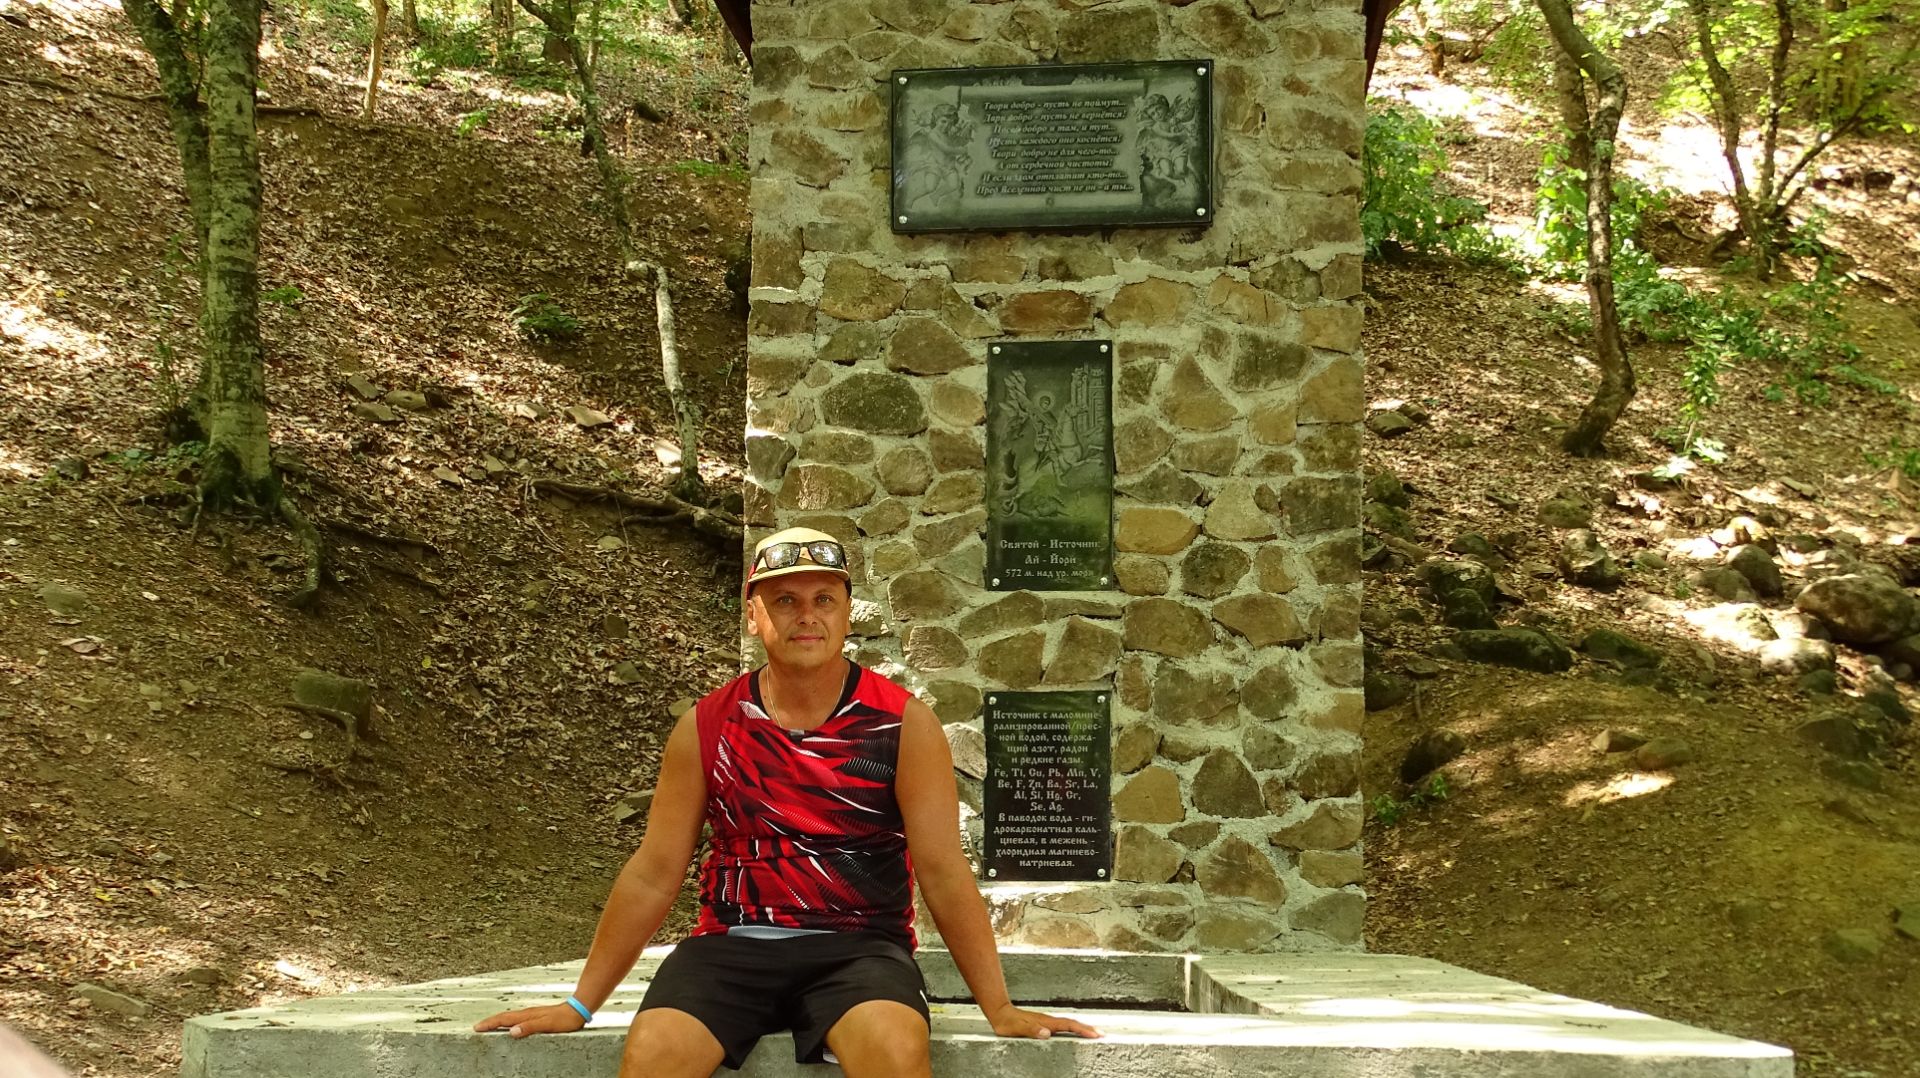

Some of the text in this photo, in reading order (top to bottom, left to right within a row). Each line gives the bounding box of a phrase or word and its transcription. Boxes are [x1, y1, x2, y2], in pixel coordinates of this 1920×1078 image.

[1011, 101, 1035, 110] добро
[1043, 101, 1069, 110] пусть
[1040, 114, 1067, 122] пусть
[1022, 125, 1047, 134] добро
[1000, 540, 1039, 549] Святой
[1024, 555, 1039, 564] Ай
[1050, 553, 1076, 566] Йори
[1005, 569, 1022, 578] 572
[1037, 570, 1053, 578] над
[1056, 570, 1069, 580] ур.
[993, 710, 1040, 719] Источник
[999, 733, 1096, 743] ной водой, содержа-
[1007, 744, 1088, 754] щий азот, радон
[1020, 757, 1054, 765] редкие
[994, 768, 1008, 778] Fe,
[1011, 768, 1025, 777] Ti,
[1028, 768, 1045, 778] Cu,
[1048, 768, 1064, 778] Pb,
[1066, 768, 1087, 777] Mn,
[997, 779, 1013, 789] Be,
[1028, 779, 1044, 790] Zn,
[1047, 779, 1062, 789] Ba,
[1065, 779, 1080, 789] Sr,
[1083, 779, 1098, 789] La,
[1014, 791, 1027, 800] Al,
[1030, 790, 1043, 800] Si,
[1046, 790, 1062, 801] Hg,
[1030, 802, 1046, 812] Se,
[1008, 815, 1047, 823] паводок
[1049, 815, 1073, 823] вода
[993, 826, 1073, 834] дрокарбонатная
[1000, 837, 1038, 845] циевая,
[995, 848, 1046, 857] хлоридная
